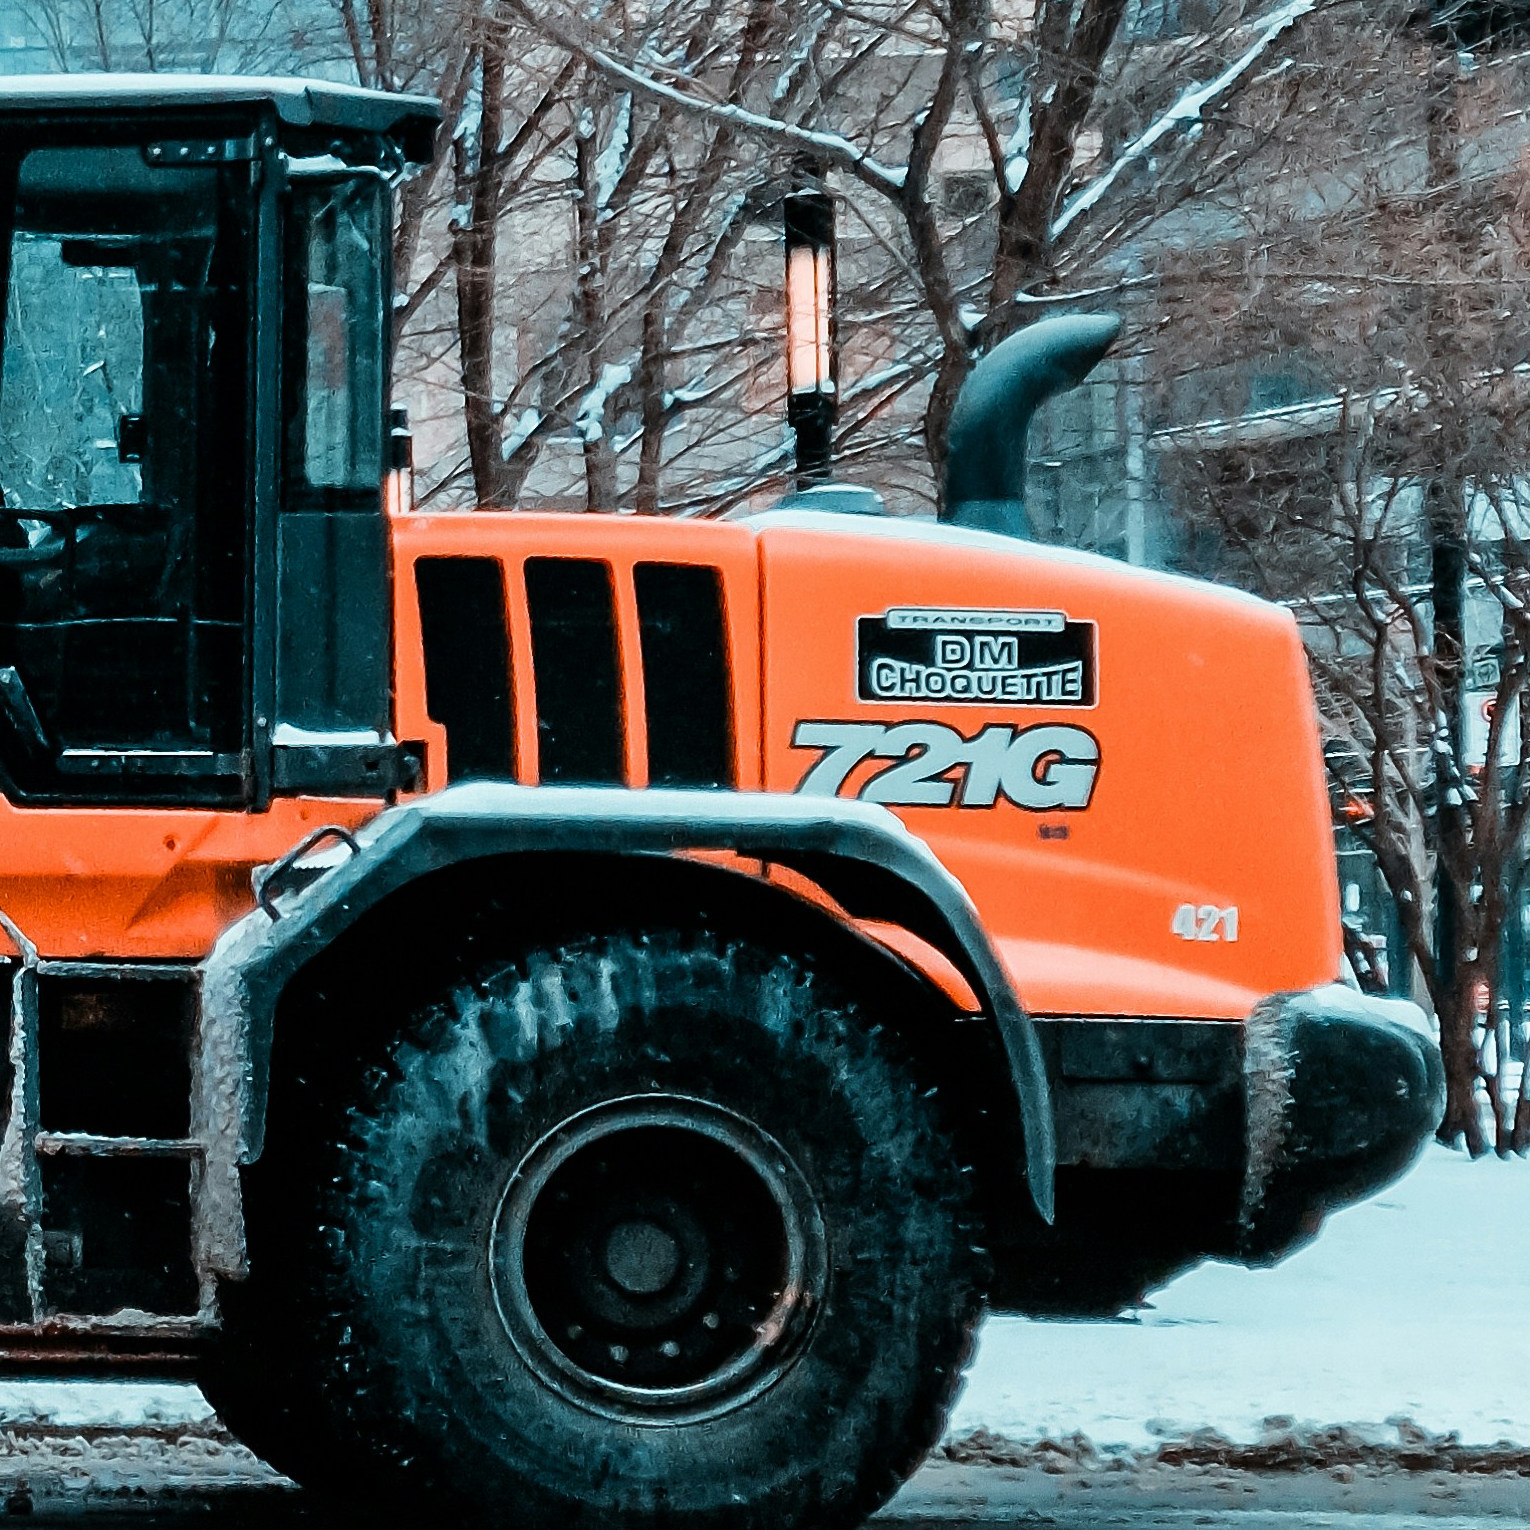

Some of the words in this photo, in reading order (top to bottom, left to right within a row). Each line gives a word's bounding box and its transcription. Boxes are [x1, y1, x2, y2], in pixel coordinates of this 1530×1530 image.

[897, 614, 1059, 627] TRANSPORT
[935, 635, 1019, 670] DM
[871, 658, 1083, 700] CHOQUETTE
[789, 719, 1102, 813] 721G
[1171, 903, 1239, 942] 421
